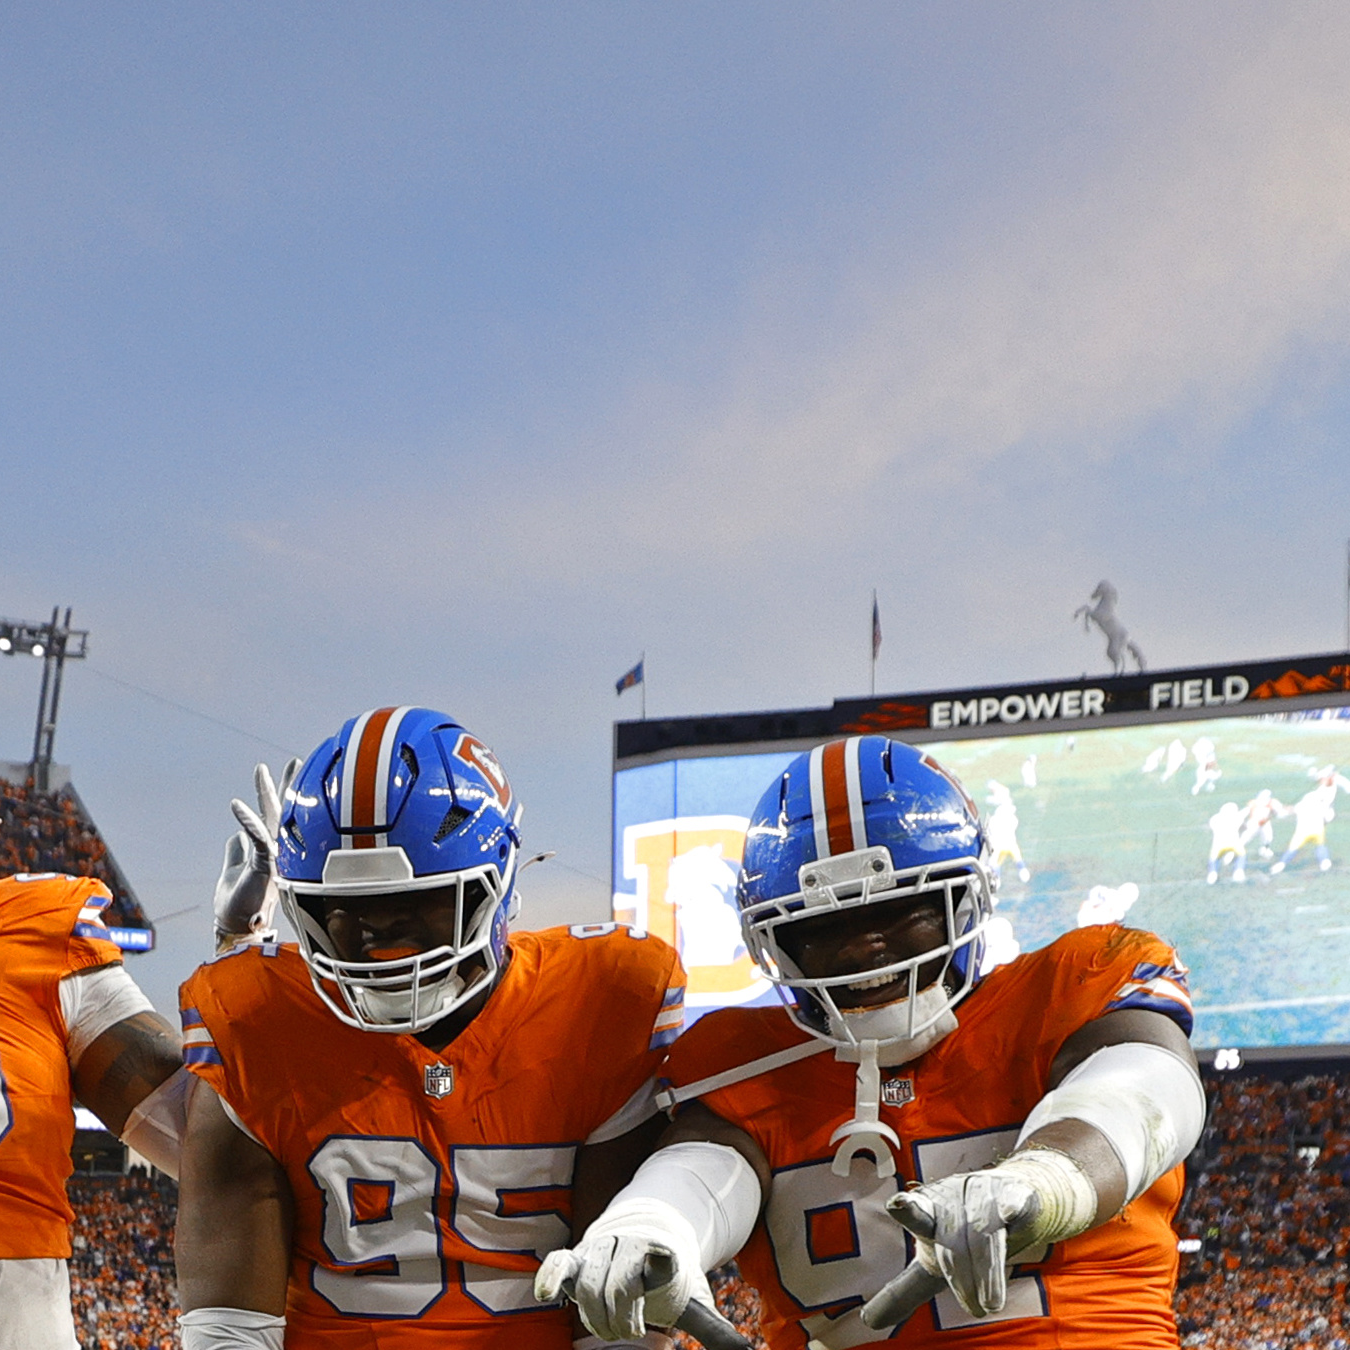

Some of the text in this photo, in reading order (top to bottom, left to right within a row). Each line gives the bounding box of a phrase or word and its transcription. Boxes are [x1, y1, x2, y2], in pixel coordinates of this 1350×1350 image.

[929, 675, 1249, 729] EMPOWER FIELD
[306, 1134, 580, 1319] 95
